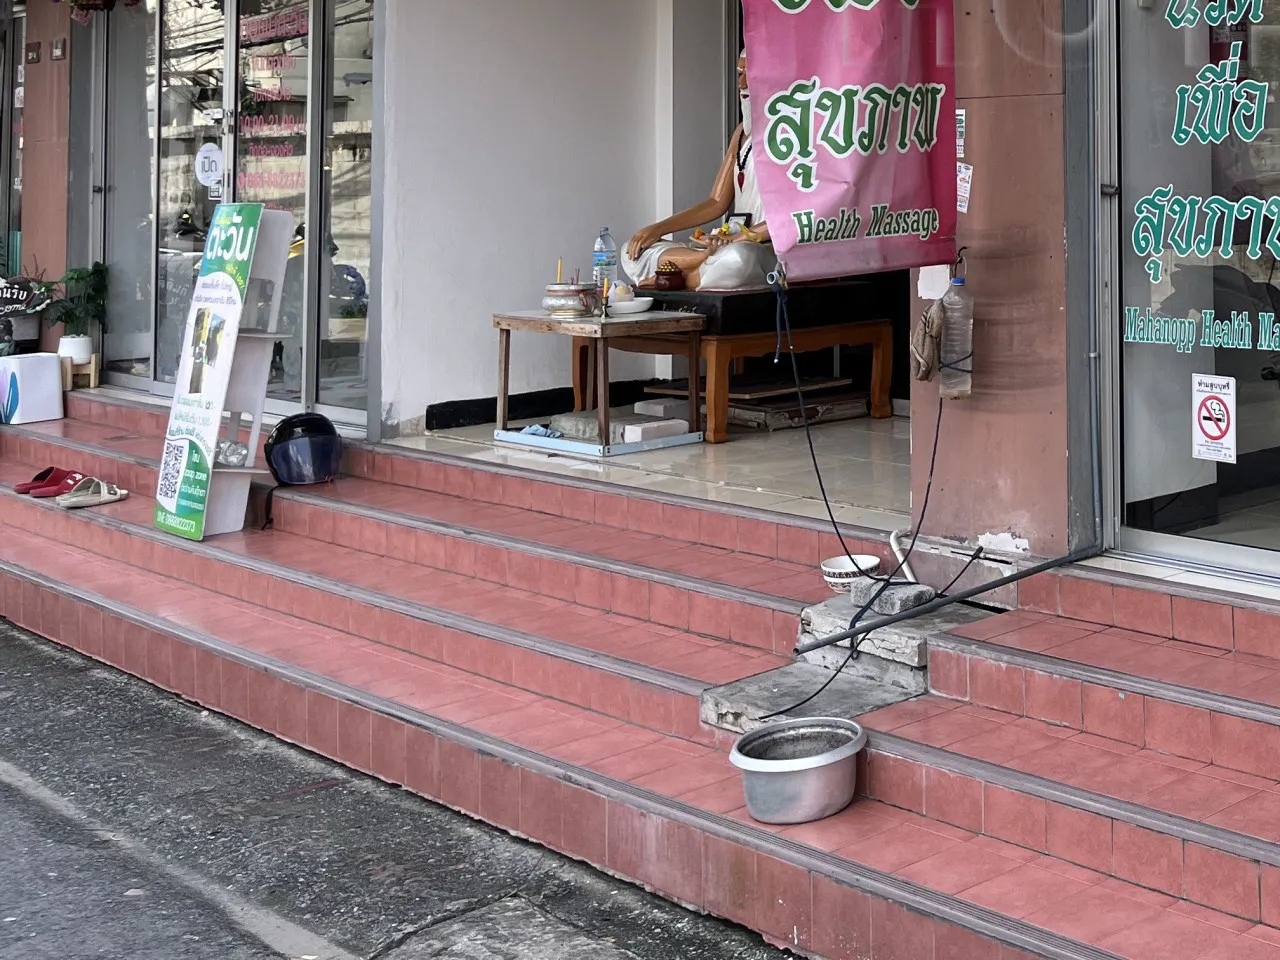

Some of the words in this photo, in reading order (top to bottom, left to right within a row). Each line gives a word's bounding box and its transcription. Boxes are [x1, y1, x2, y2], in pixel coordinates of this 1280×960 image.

[1169, 40, 1269, 147] เพื่อ
[763, 74, 947, 193] สุขภาพ
[201, 156, 218, 168] เปิด
[206, 212, 254, 261] ตะวัน
[793, 206, 862, 245] Health
[868, 202, 939, 242] Massage
[0, 283, 27, 301] นรับ
[1124, 306, 1197, 353] Mahanopp
[1200, 309, 1252, 349] Health
